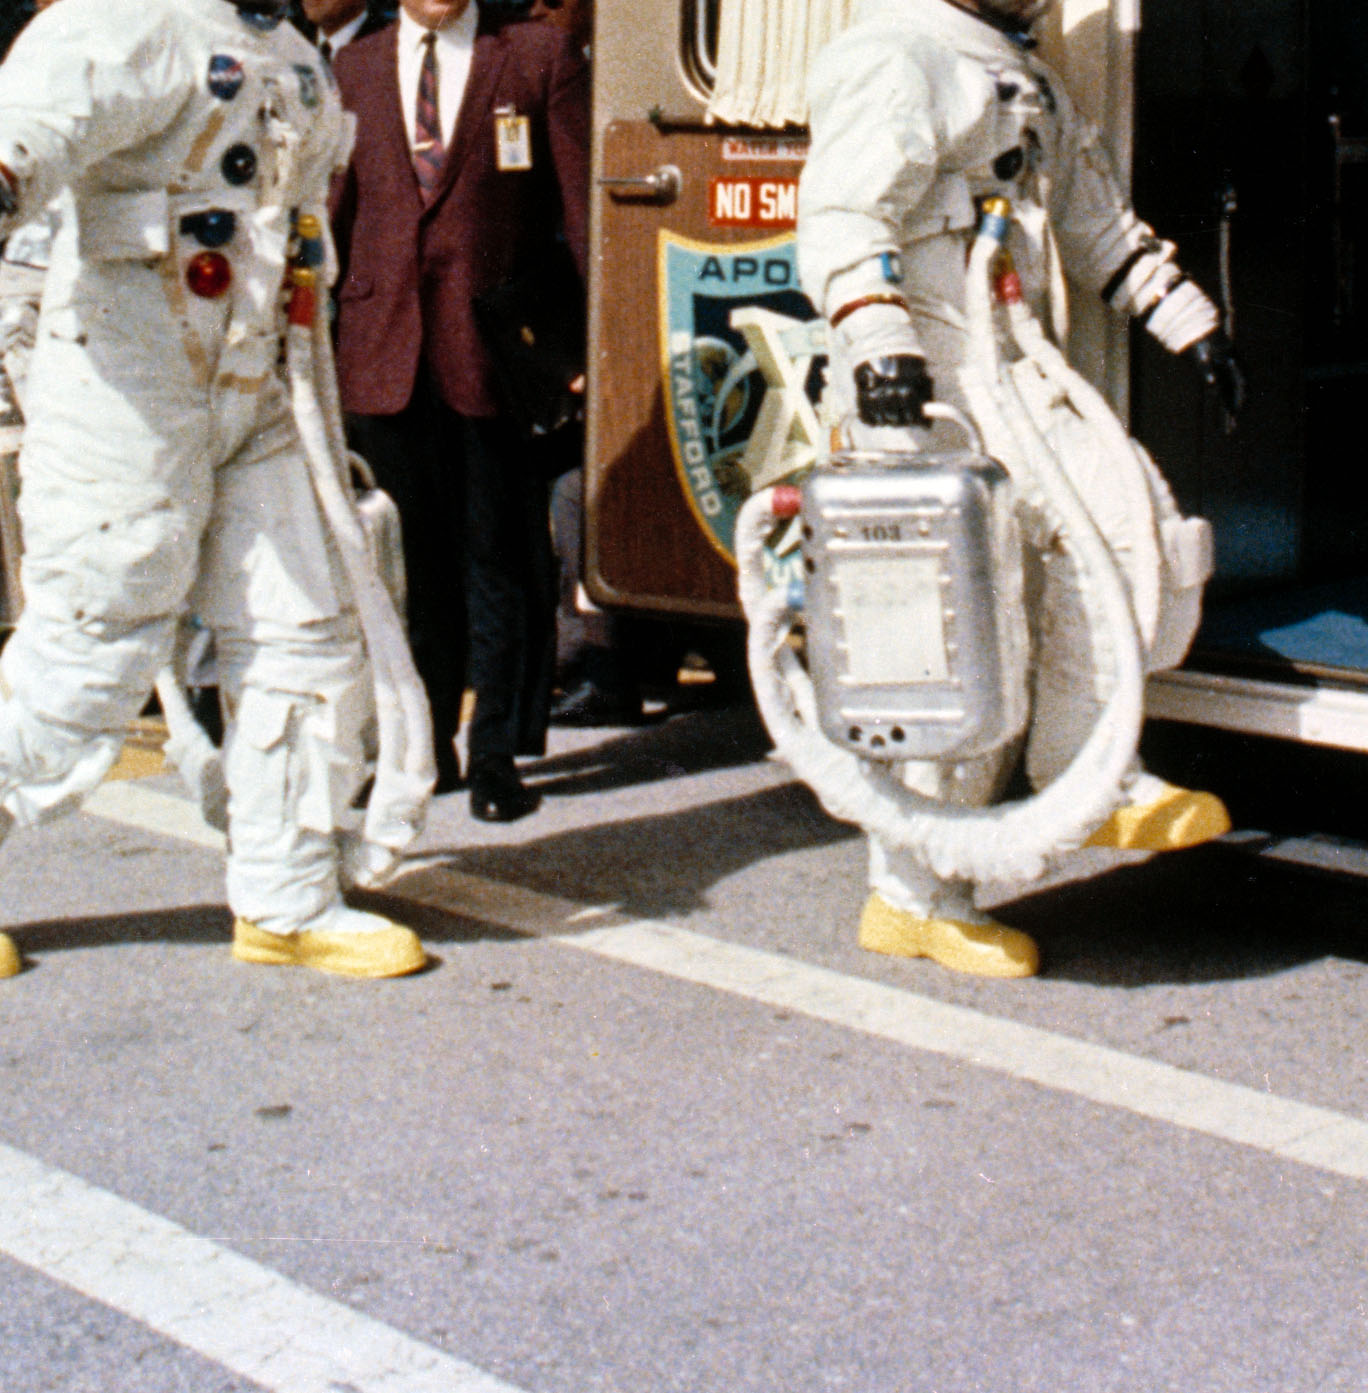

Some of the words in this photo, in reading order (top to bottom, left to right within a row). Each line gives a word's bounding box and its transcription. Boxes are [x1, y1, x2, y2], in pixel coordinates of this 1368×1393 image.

[716, 182, 751, 219] NO
[759, 182, 796, 220] SM
[697, 255, 801, 285] APO
[672, 331, 723, 517] TAFFORD
